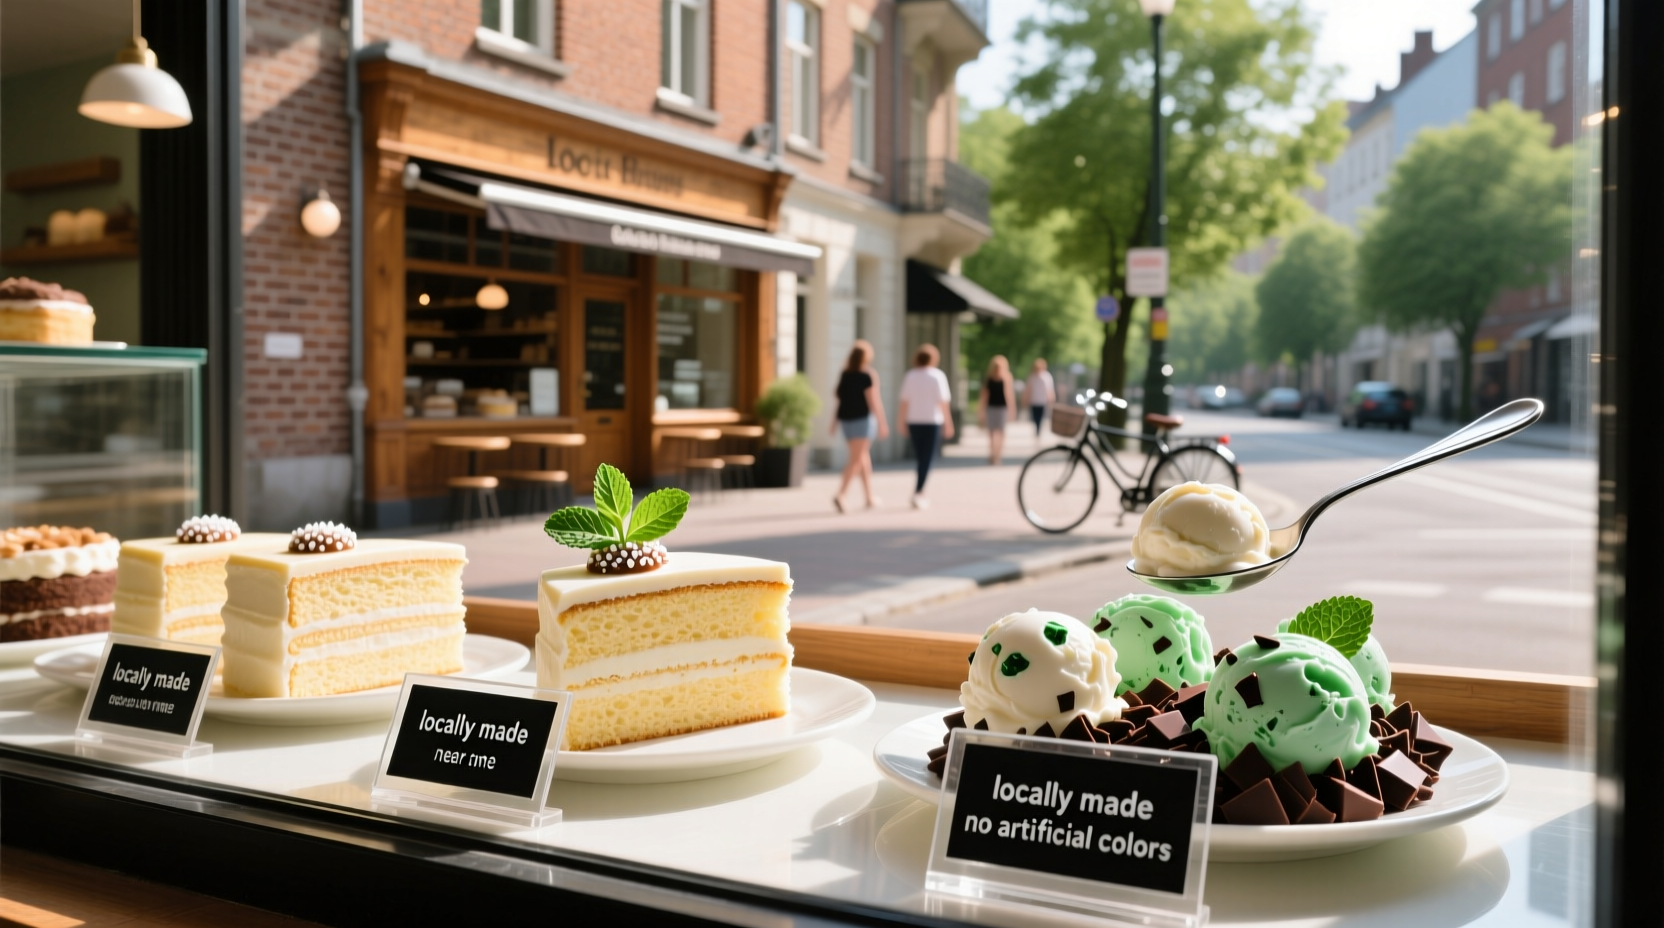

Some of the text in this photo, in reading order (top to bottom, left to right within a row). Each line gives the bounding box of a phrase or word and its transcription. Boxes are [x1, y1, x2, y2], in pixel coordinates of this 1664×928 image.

[153, 671, 191, 692] made
[418, 708, 529, 745] locally made
[433, 748, 467, 765] near
[992, 773, 1154, 820] locally made
[964, 814, 1172, 862] no artificial colors
